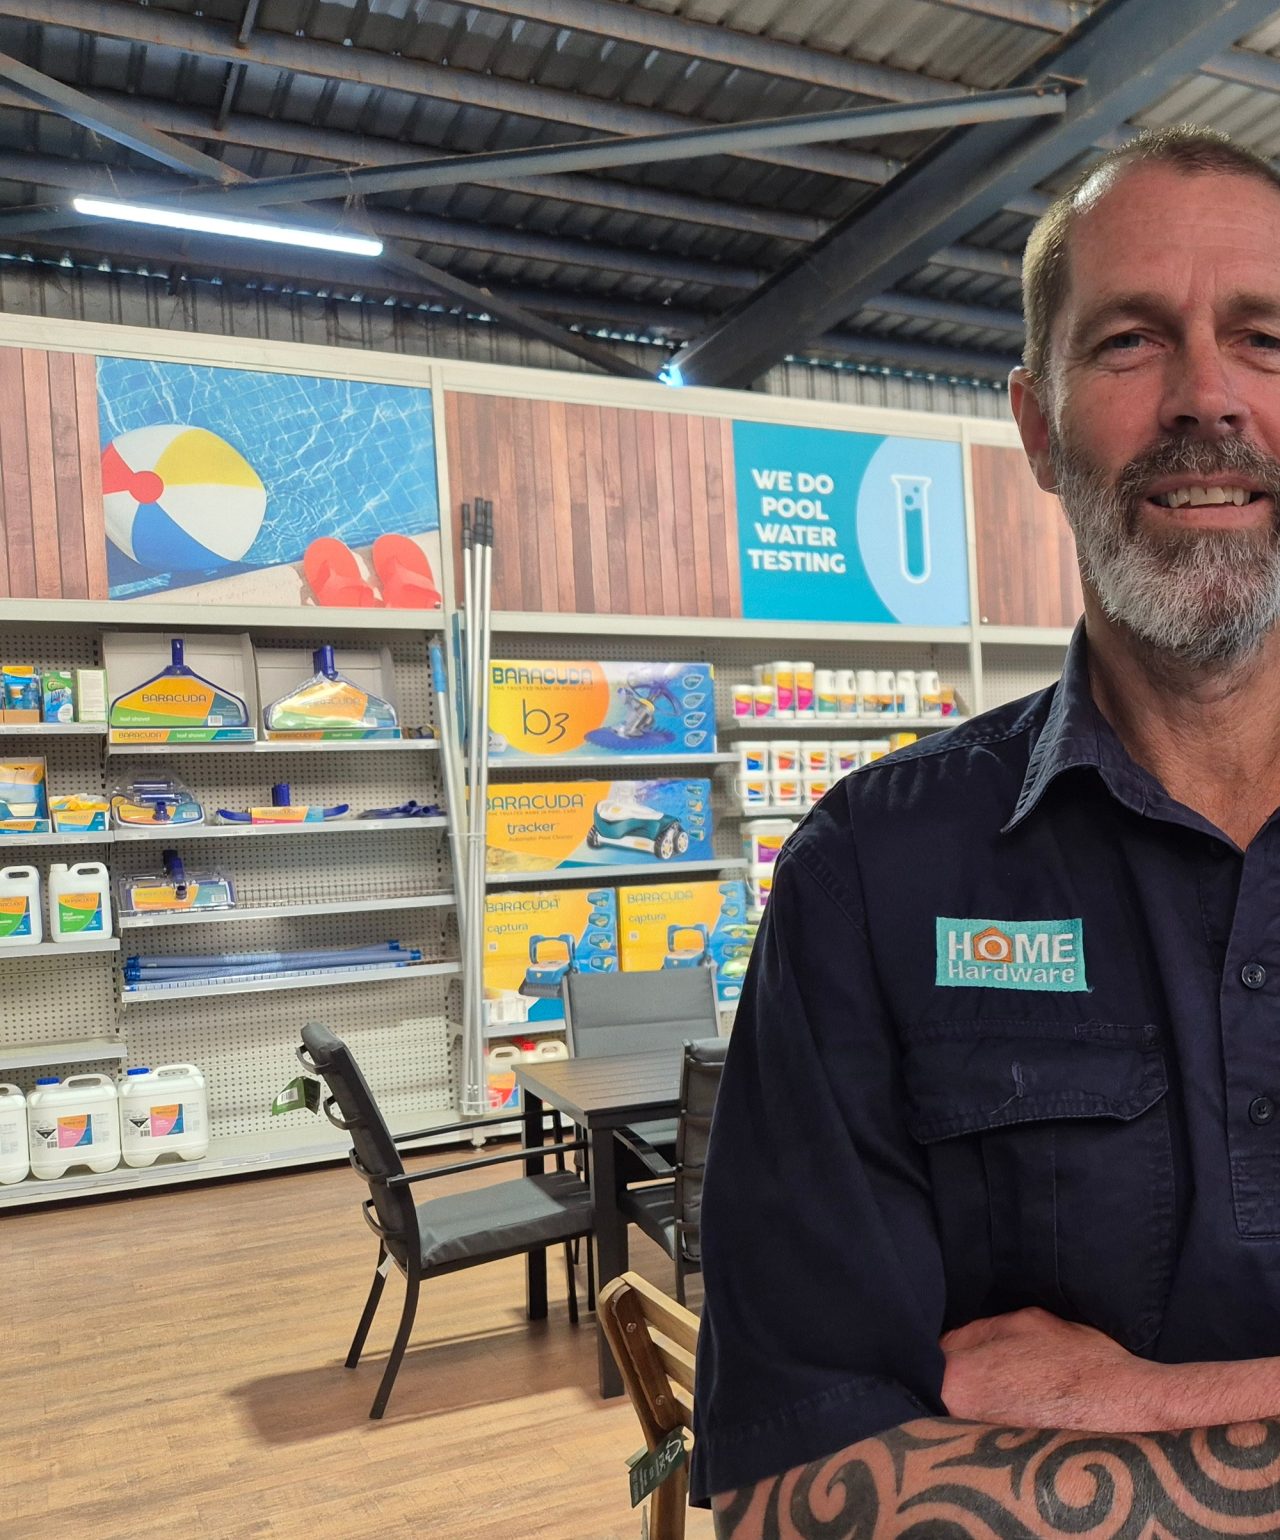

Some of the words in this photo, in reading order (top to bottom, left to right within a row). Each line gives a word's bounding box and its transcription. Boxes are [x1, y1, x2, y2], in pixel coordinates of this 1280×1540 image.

[751, 468, 793, 492] WE
[797, 472, 834, 495] DO
[761, 496, 829, 520] POOL
[754, 522, 837, 547] WATER
[747, 549, 846, 574] TESTING
[492, 667, 593, 686] BARACUDA
[142, 693, 207, 703] BARACUDA
[522, 698, 570, 744] b3
[507, 822, 556, 835] tracker
[486, 898, 559, 913] BARACUDA
[627, 890, 693, 904] BARACUDA
[487, 922, 529, 935] captura
[628, 913, 667, 924] captura
[948, 930, 1076, 964] HOME
[948, 961, 1075, 984] Hardware
